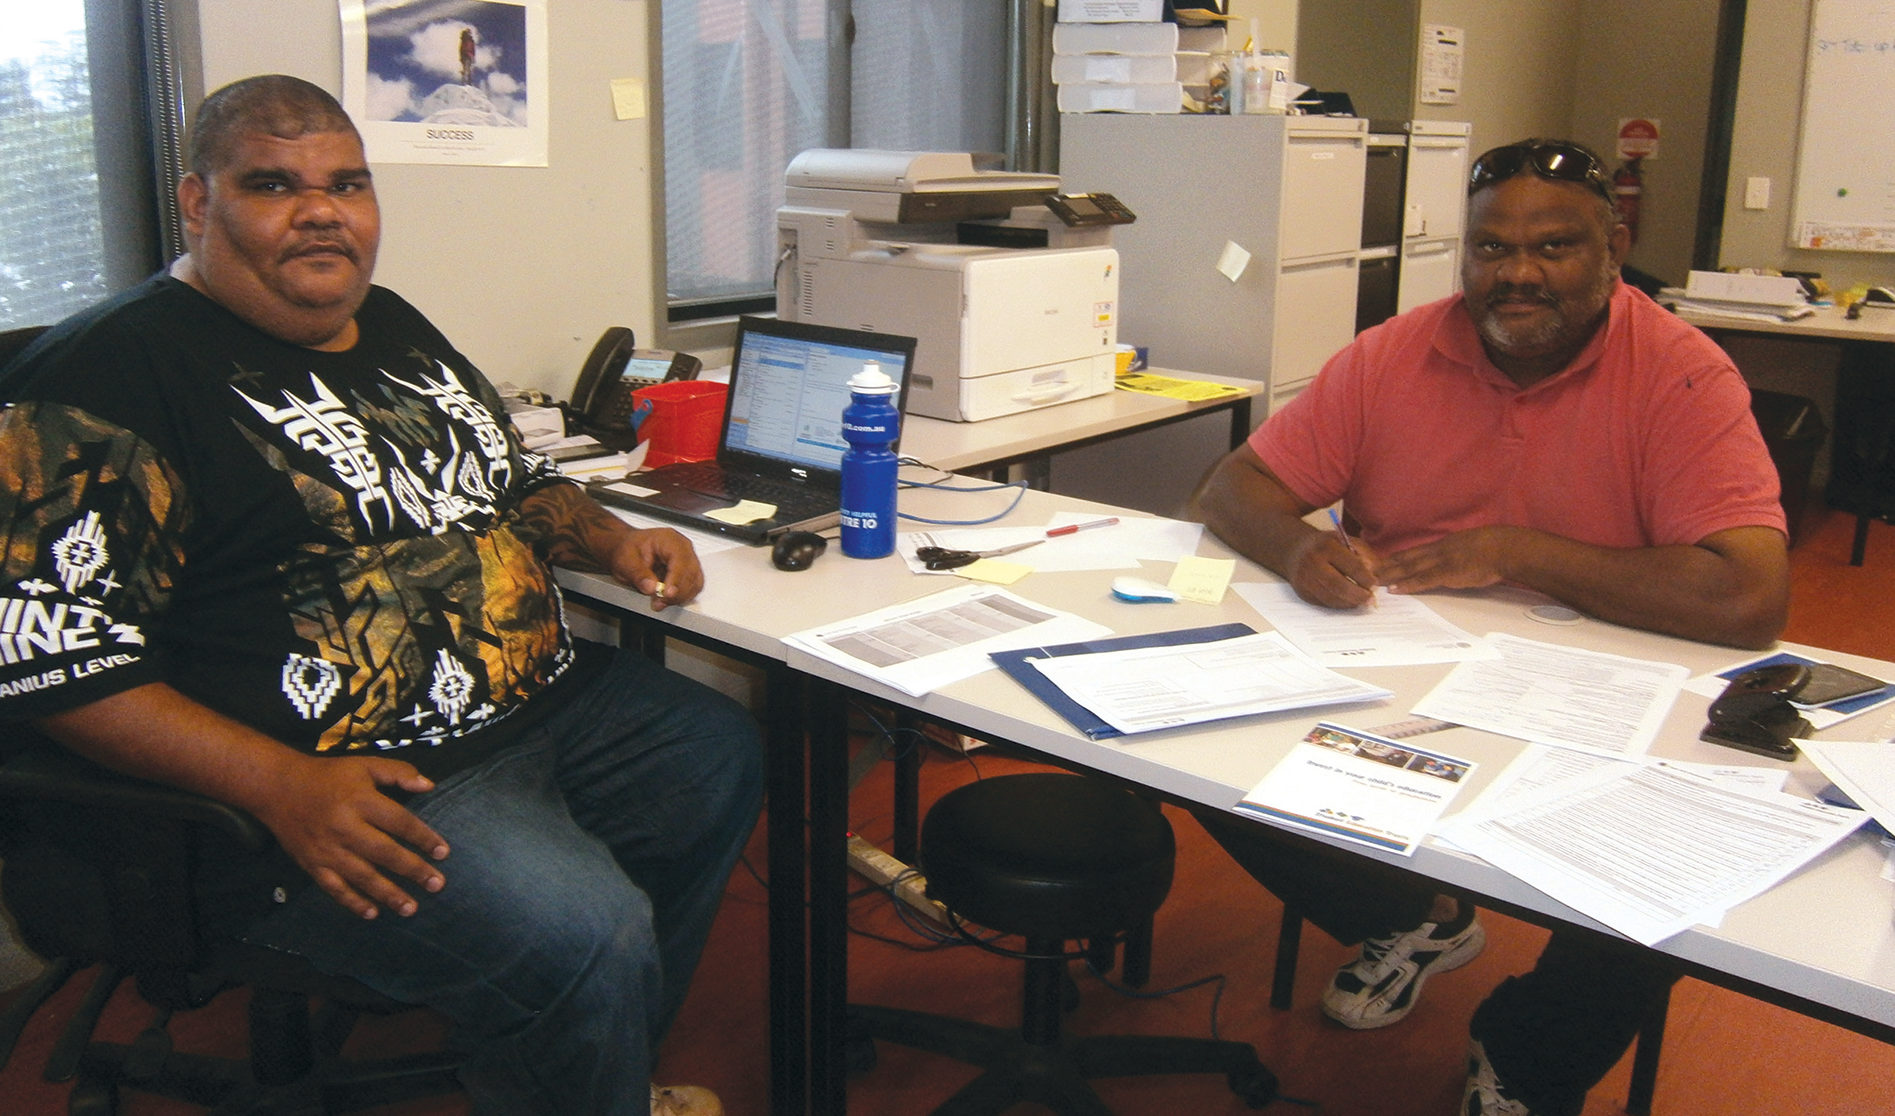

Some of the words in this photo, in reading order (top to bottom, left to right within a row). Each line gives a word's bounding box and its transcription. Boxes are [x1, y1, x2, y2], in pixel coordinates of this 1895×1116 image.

[426, 129, 474, 141] SUCCESS
[862, 518, 878, 529] 10
[72, 653, 141, 679] LEVEL
